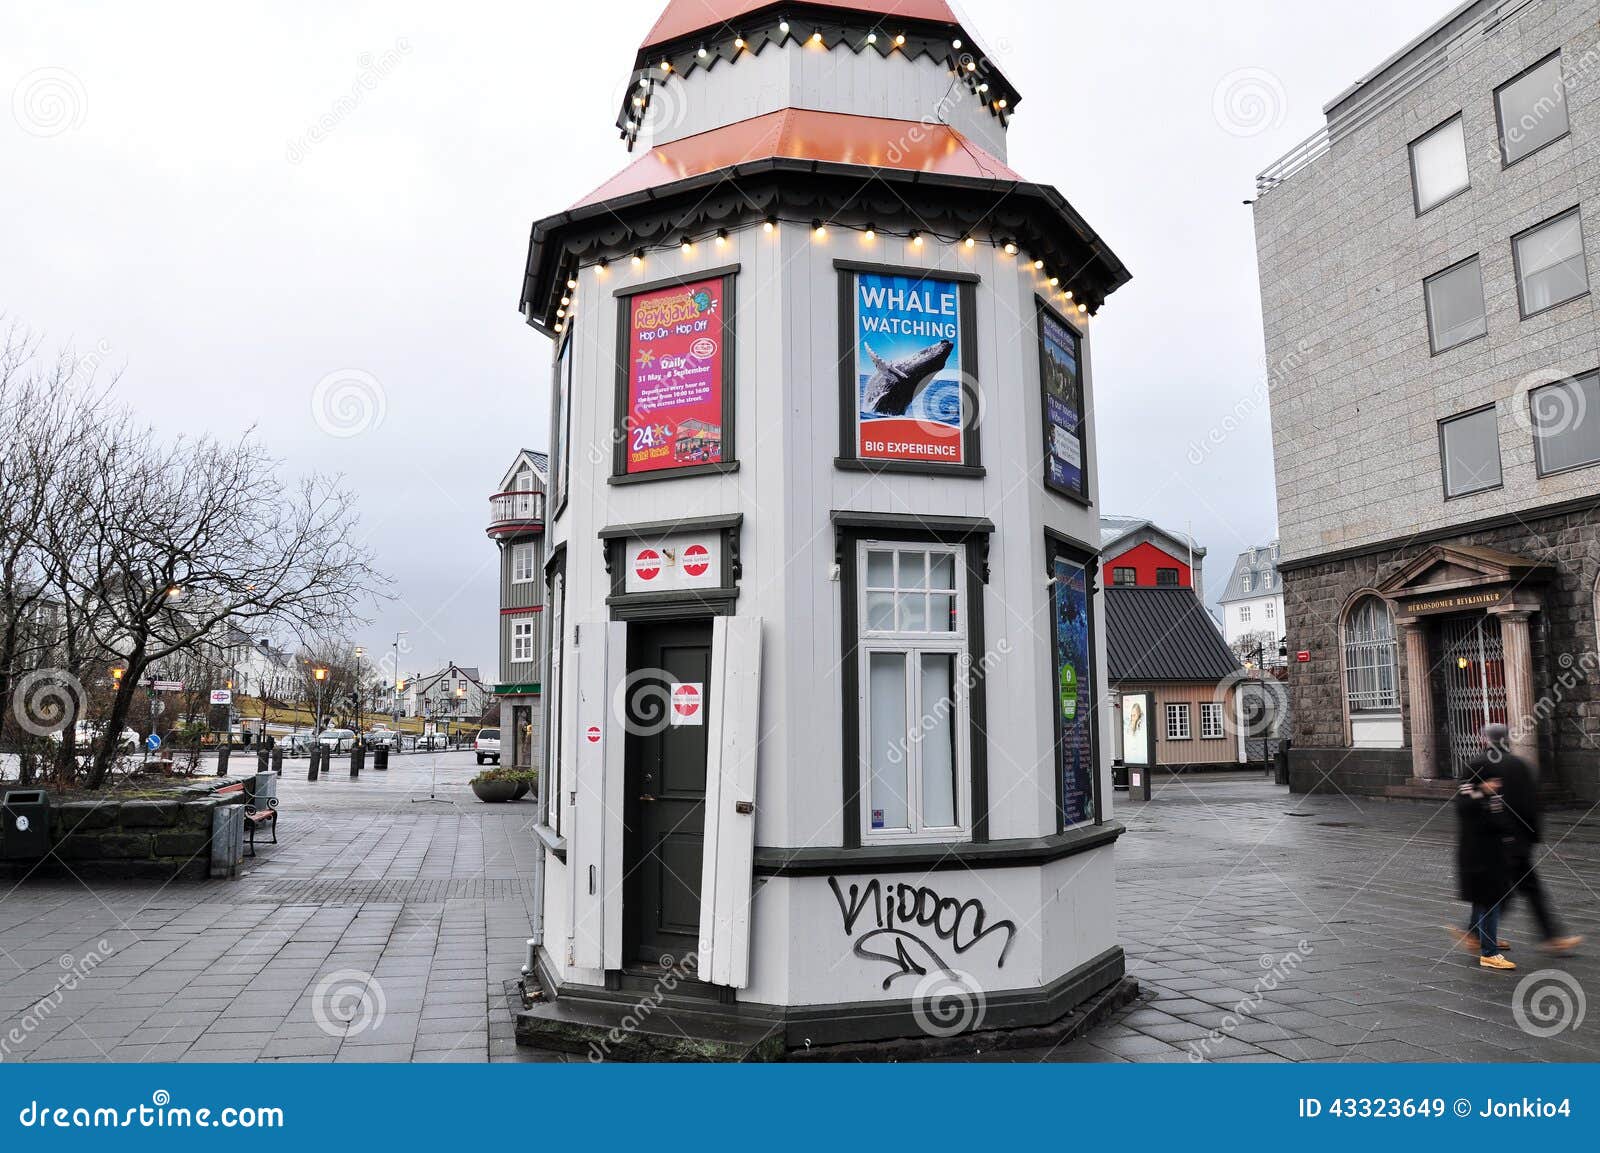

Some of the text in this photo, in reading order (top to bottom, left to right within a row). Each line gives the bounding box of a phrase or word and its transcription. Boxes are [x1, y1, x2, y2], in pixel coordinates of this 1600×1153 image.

[861, 285, 955, 315] WHALE
[639, 331, 655, 341] Hop
[657, 327, 669, 338] On
[675, 324, 693, 335] Hop
[694, 320, 708, 331] Off
[862, 316, 956, 338] WATCHING
[647, 373, 661, 382] May
[673, 365, 710, 378] September
[661, 357, 686, 370] Daily
[633, 425, 653, 451] 24
[865, 441, 956, 456] BIG EXPERIENCE
